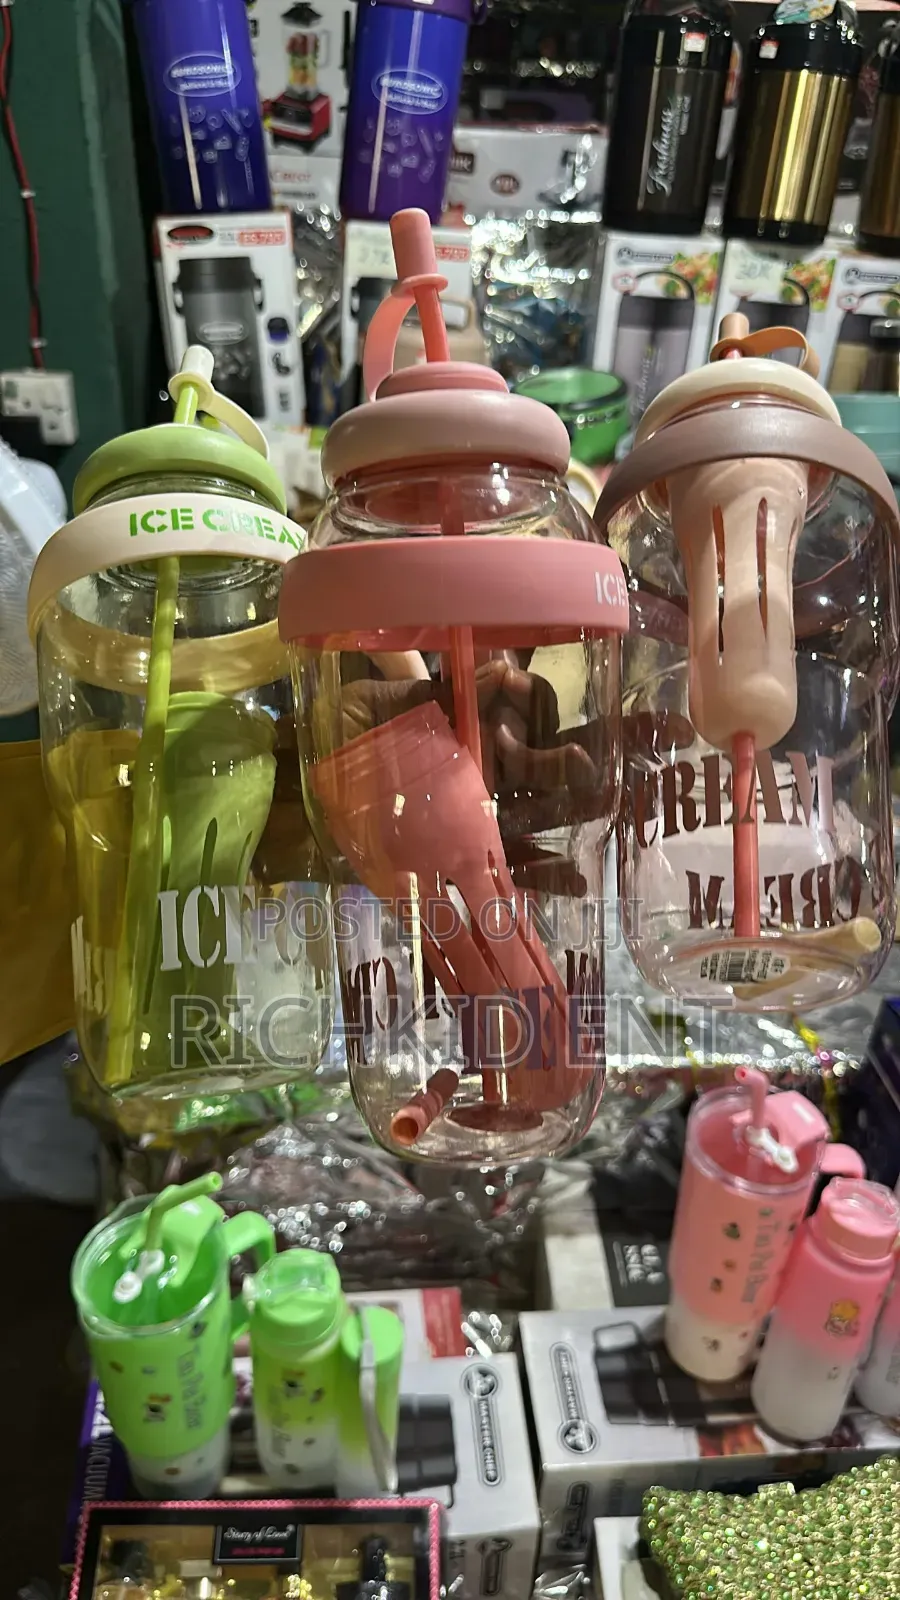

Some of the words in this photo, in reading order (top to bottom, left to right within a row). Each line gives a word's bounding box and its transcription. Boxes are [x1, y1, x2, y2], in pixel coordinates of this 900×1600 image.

[129, 507, 194, 537] ICE
[595, 571, 626, 606] ICE
[632, 750, 837, 849] CREAM
[157, 884, 259, 971] ICE
[479, 1400, 493, 1446] MASTER
[82, 1437, 112, 1500] VACUUM
